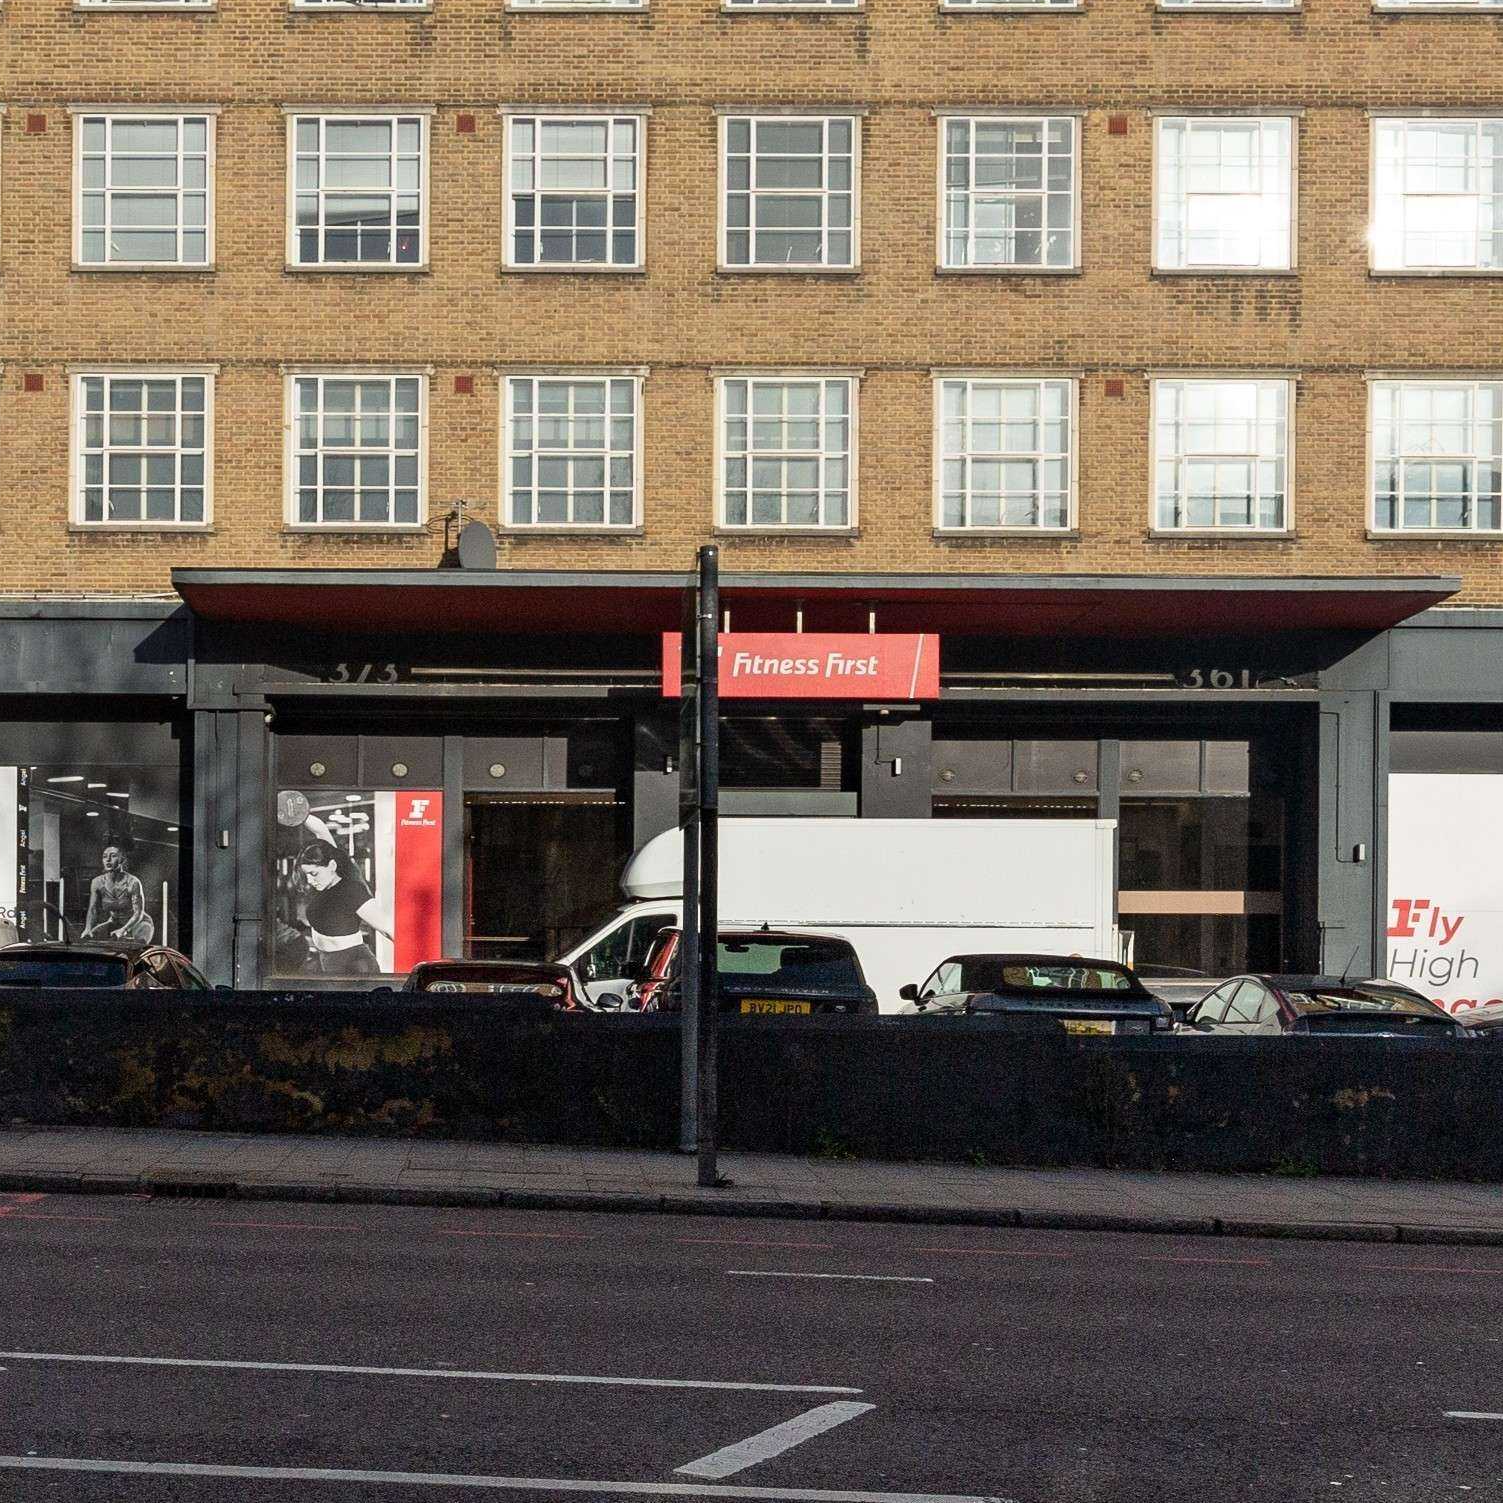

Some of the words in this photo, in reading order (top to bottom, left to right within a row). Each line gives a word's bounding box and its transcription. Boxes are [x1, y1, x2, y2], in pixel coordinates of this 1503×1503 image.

[732, 652, 819, 677] Fitness
[825, 652, 878, 678] First
[1183, 669, 1250, 688] 361
[1390, 949, 1479, 986] High
